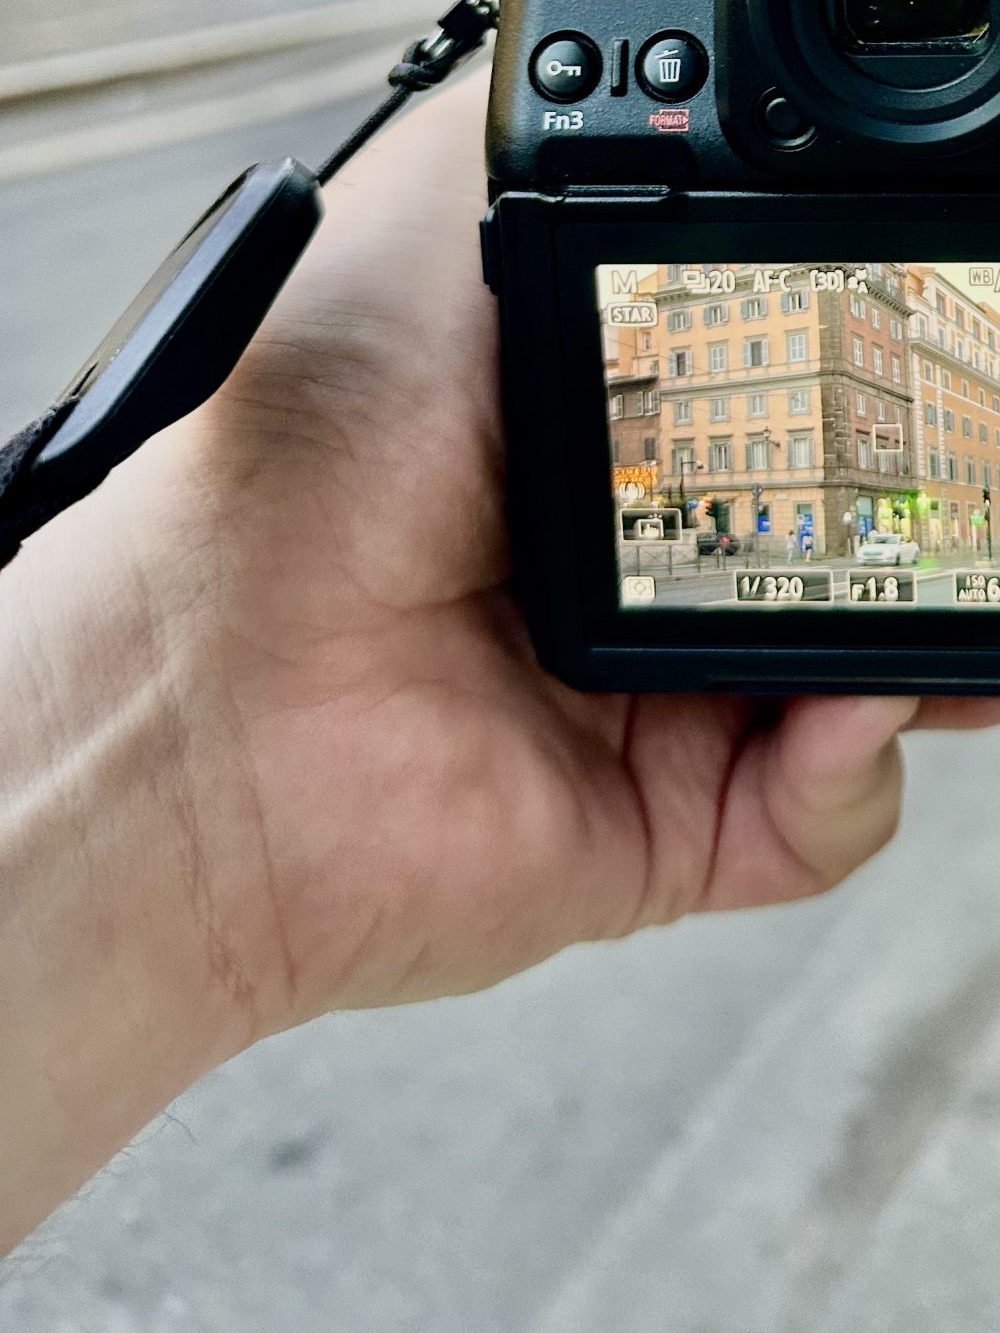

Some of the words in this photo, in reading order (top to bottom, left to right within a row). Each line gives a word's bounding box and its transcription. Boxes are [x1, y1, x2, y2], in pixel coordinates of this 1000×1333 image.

[543, 111, 584, 130] Fn3
[612, 270, 638, 294] M
[752, 269, 792, 293] AF-C
[972, 270, 991, 284] WB
[613, 306, 653, 322] STAR
[739, 575, 804, 602] 1/320
[965, 574, 986, 588] ISO
[957, 588, 986, 602] AUTO
